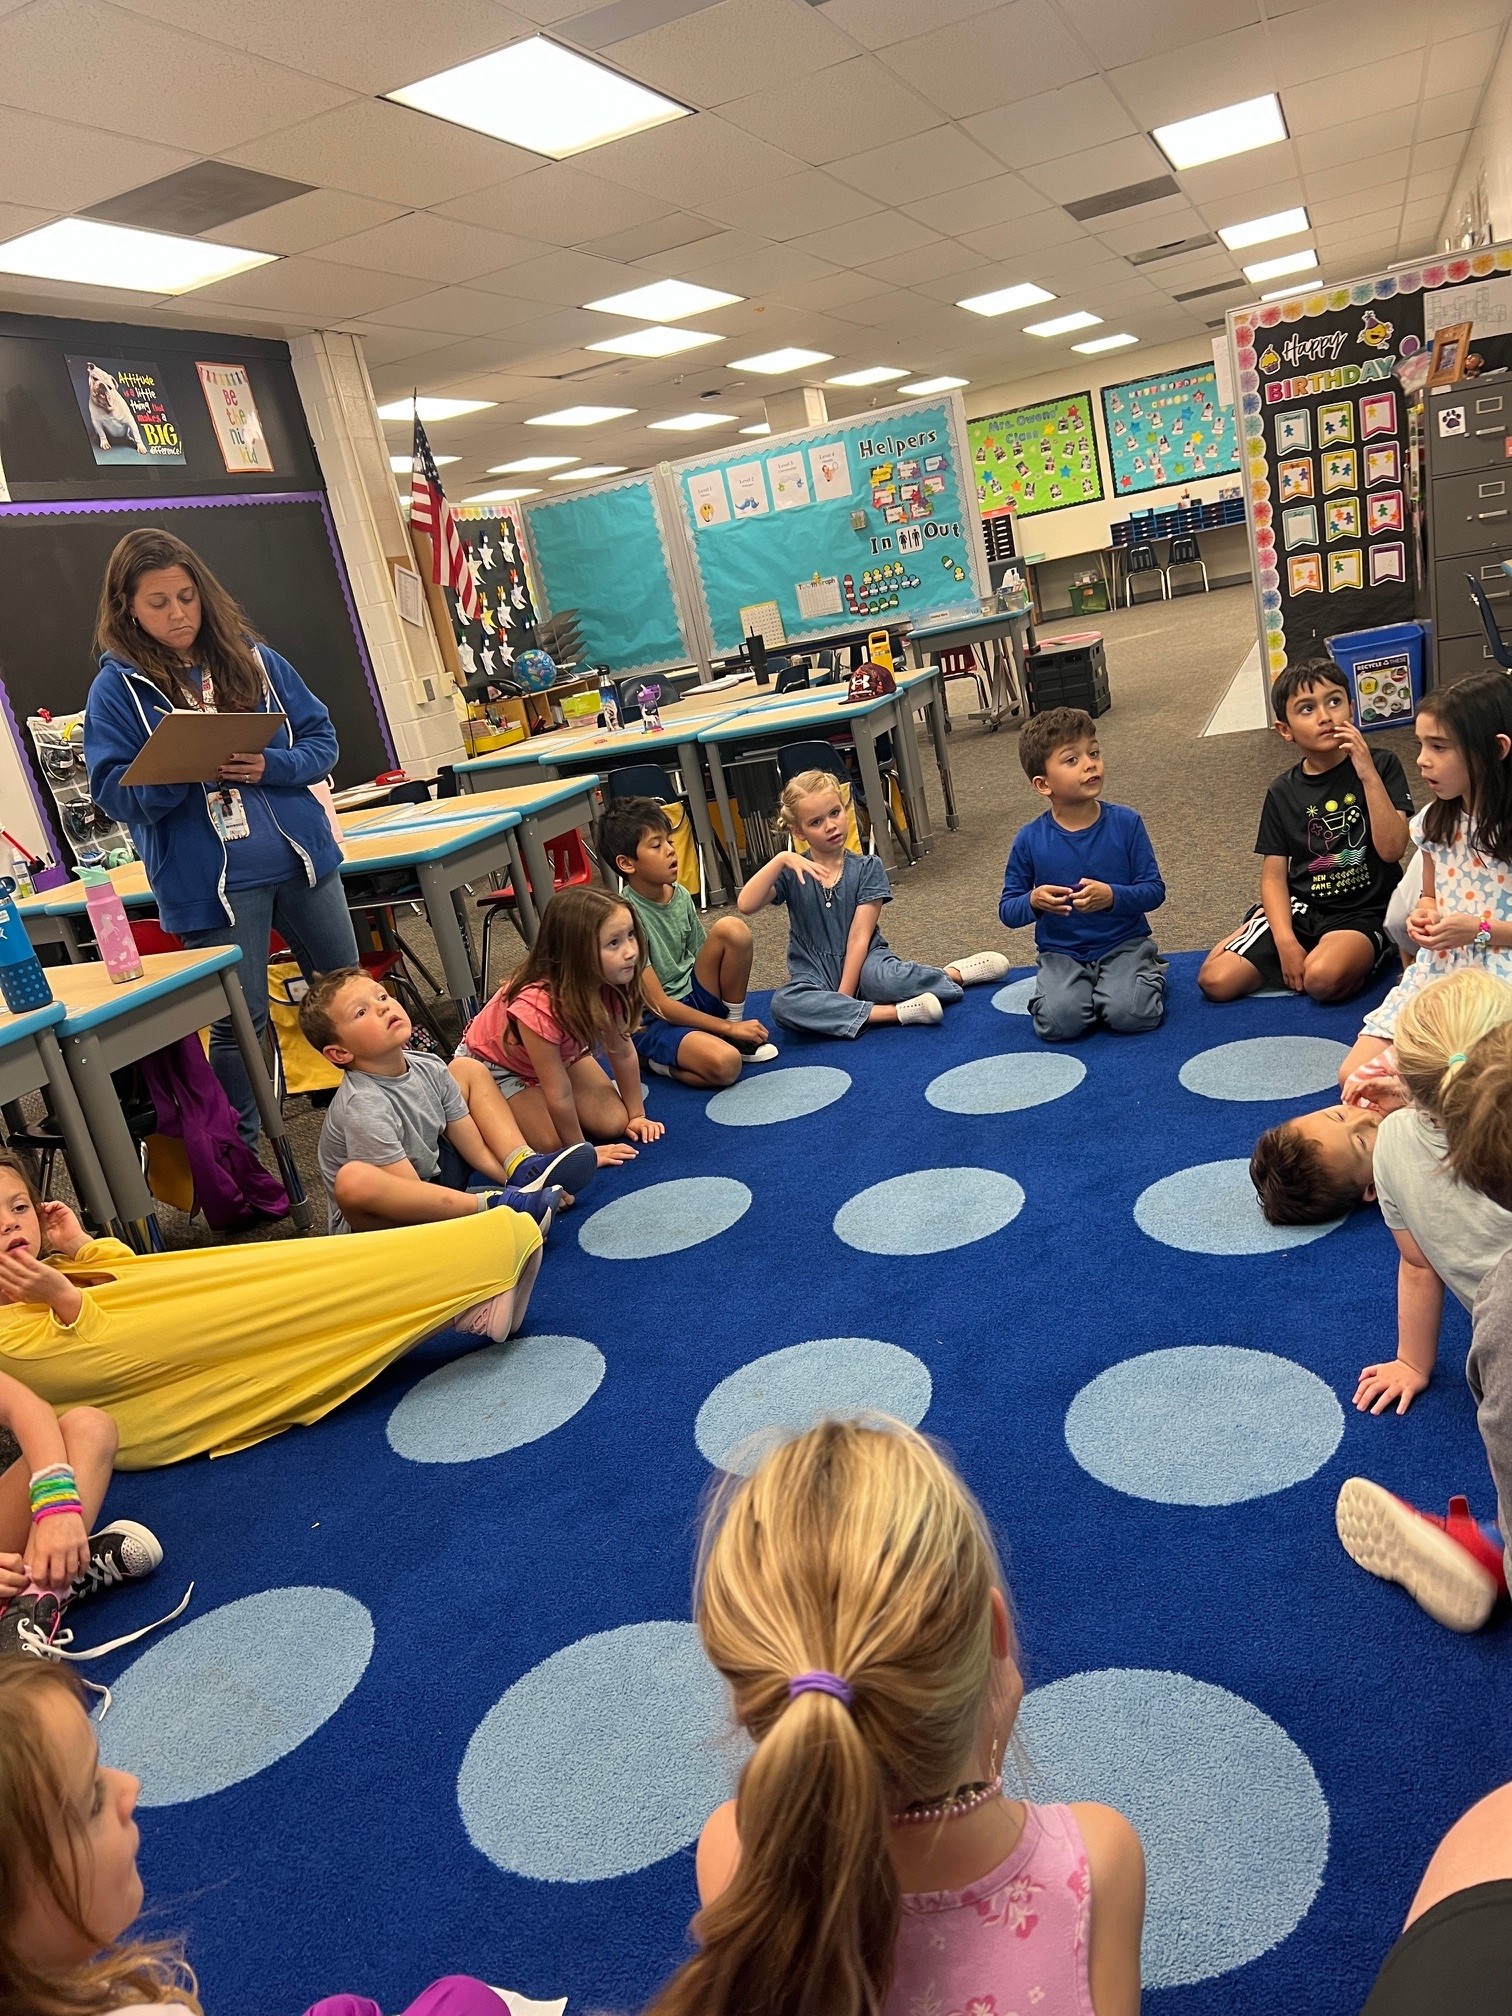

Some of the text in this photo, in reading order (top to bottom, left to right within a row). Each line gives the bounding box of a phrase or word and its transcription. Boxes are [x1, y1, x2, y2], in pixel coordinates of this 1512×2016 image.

[1282, 331, 1348, 366] Happy
[118, 371, 155, 388] Attitude
[1265, 355, 1396, 404] BIRTHDAY
[134, 387, 156, 401] little
[130, 399, 151, 414] thing
[136, 412, 161, 423] makes
[226, 408, 247, 426] the
[141, 422, 179, 446] BIG
[988, 420, 1014, 433] Mrs.
[1005, 429, 1039, 444] Class
[859, 430, 938, 459] Helpers
[870, 522, 960, 555] In Out
[1356, 661, 1382, 671] RECYCLE
[1312, 874, 1326, 882] NEW
[1310, 882, 1332, 891] GAME
